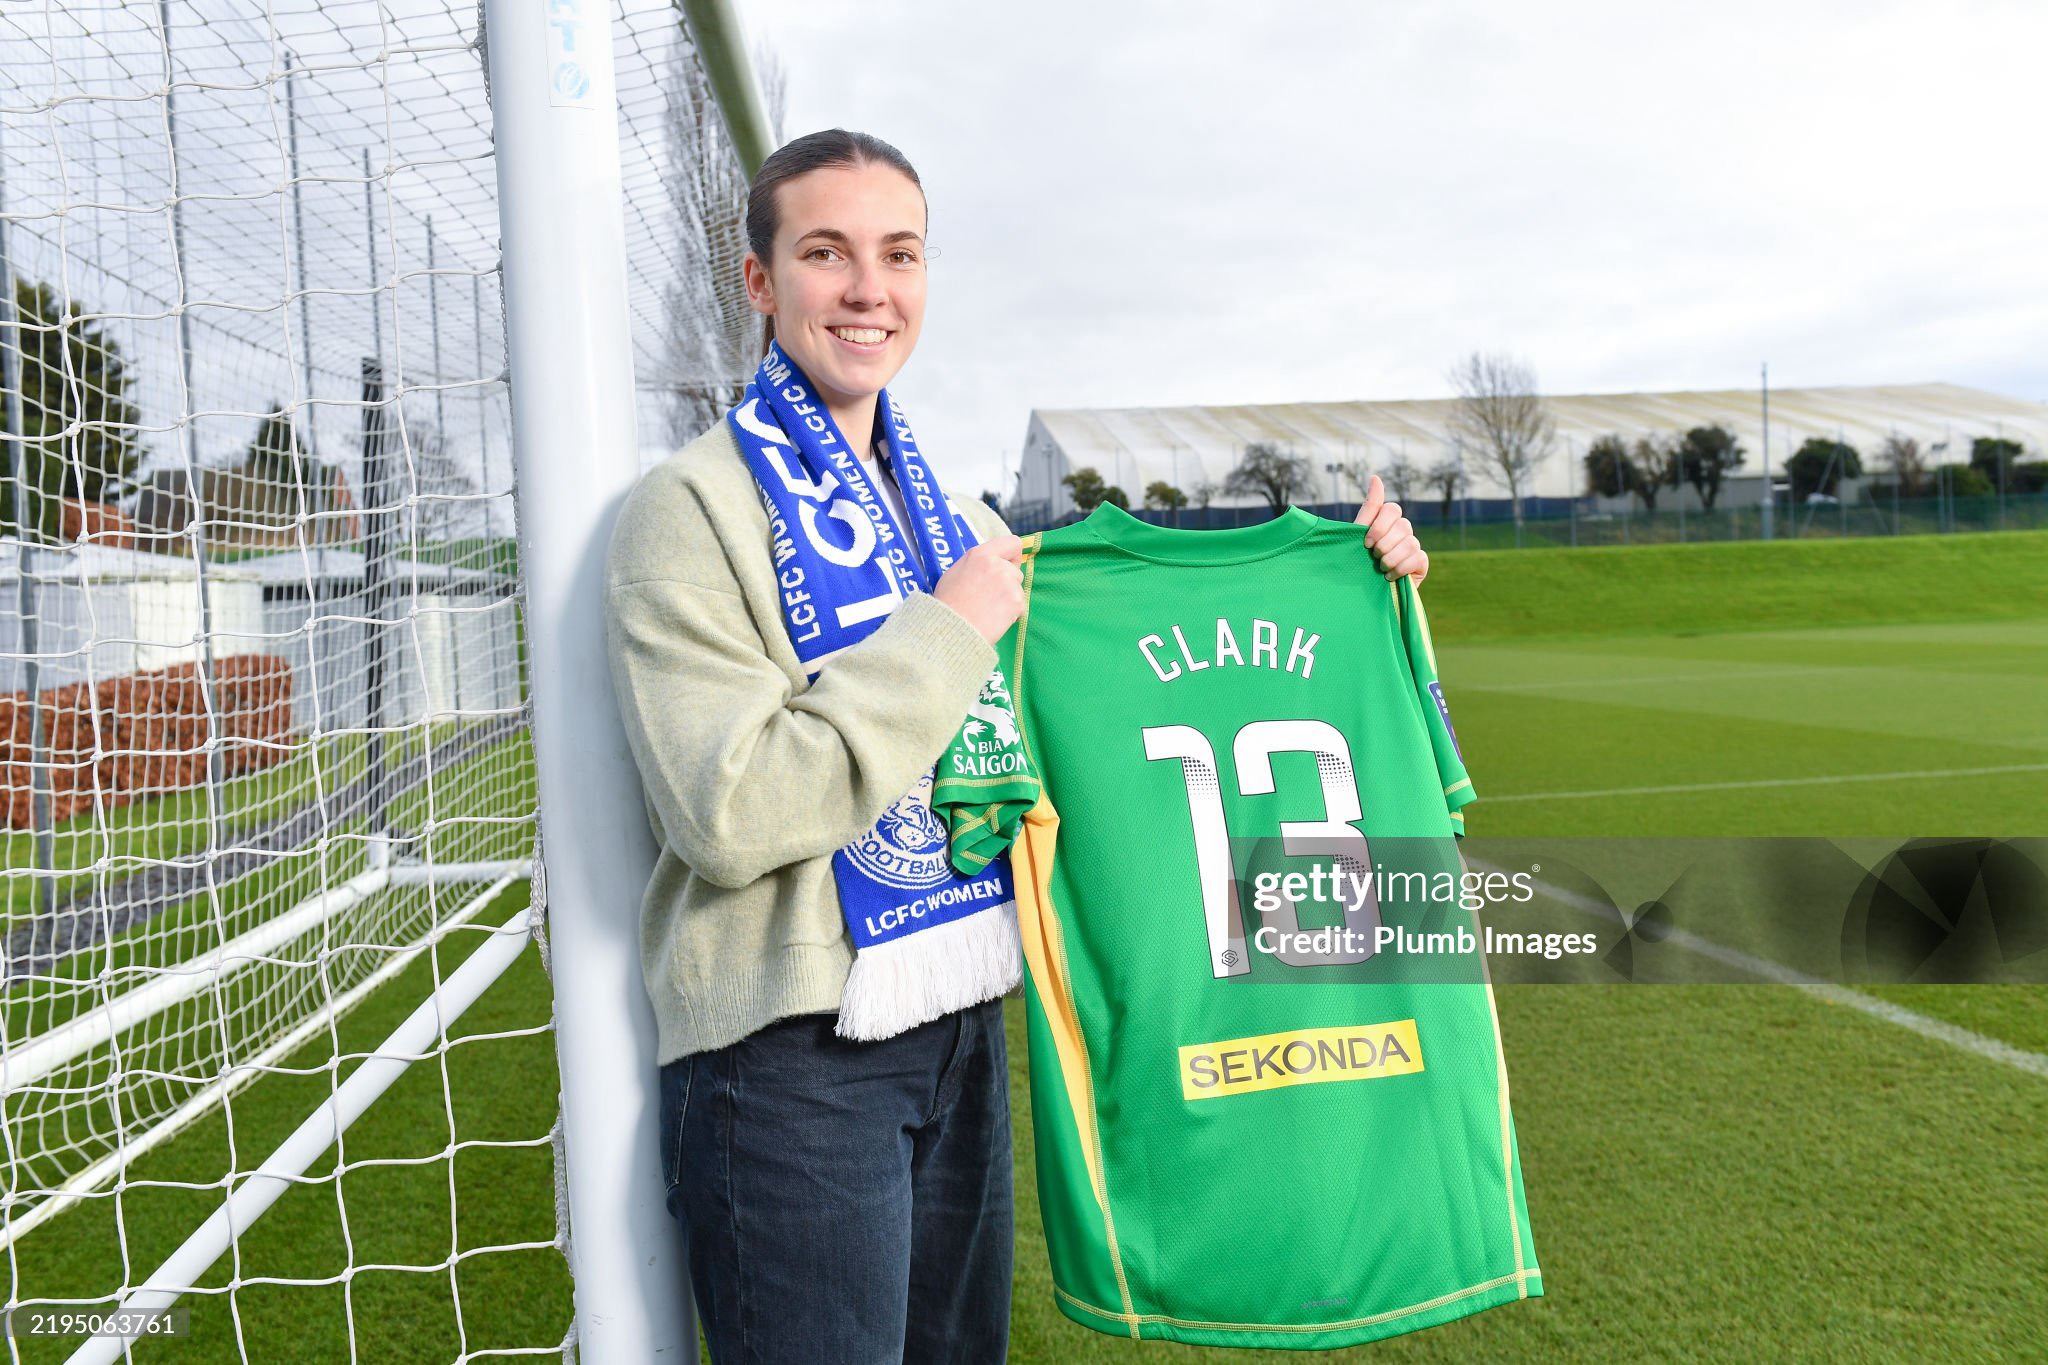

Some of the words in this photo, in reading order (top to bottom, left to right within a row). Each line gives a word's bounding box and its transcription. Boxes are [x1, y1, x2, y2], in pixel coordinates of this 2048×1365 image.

[782, 385, 837, 445] LCFC
[830, 451, 895, 542] WOMEN
[902, 449, 935, 511] LCFC
[889, 548, 919, 596] CFC
[780, 566, 822, 643] LCFC
[1138, 617, 1322, 683] CLARK
[953, 752, 1030, 776] SAIGON
[978, 740, 1003, 754] BIA
[862, 830, 948, 875] OOTBAL
[1141, 719, 1384, 979] 13
[1189, 1033, 1411, 1089] SEKONDA
